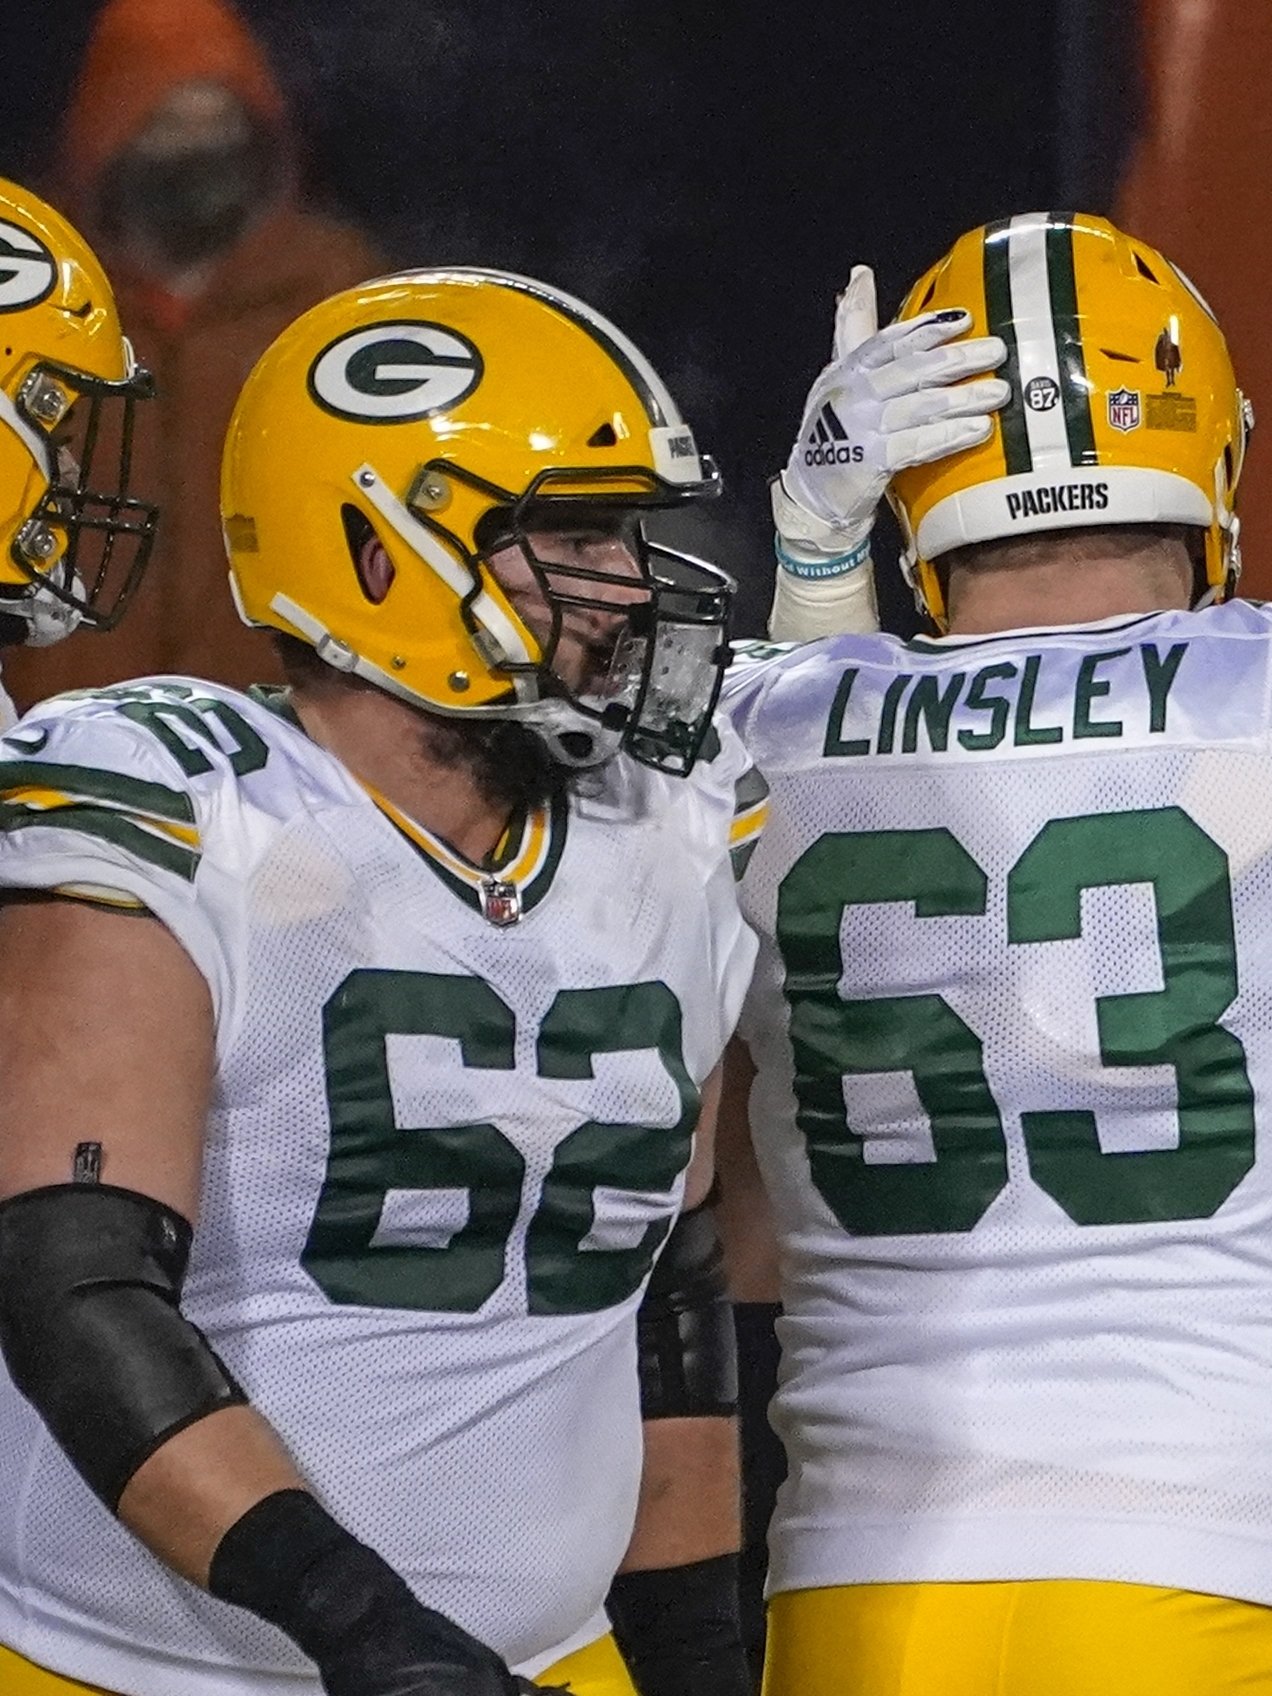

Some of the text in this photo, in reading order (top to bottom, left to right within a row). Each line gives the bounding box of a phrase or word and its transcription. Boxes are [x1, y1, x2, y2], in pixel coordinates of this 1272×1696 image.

[1029, 387, 1056, 410] 87
[1111, 404, 1138, 426] NFL
[1005, 482, 1109, 520] PACKERS
[797, 558, 856, 577] Without
[823, 642, 1189, 757] LINSLEY
[776, 804, 1256, 1237] 63
[300, 967, 700, 1317] 62
